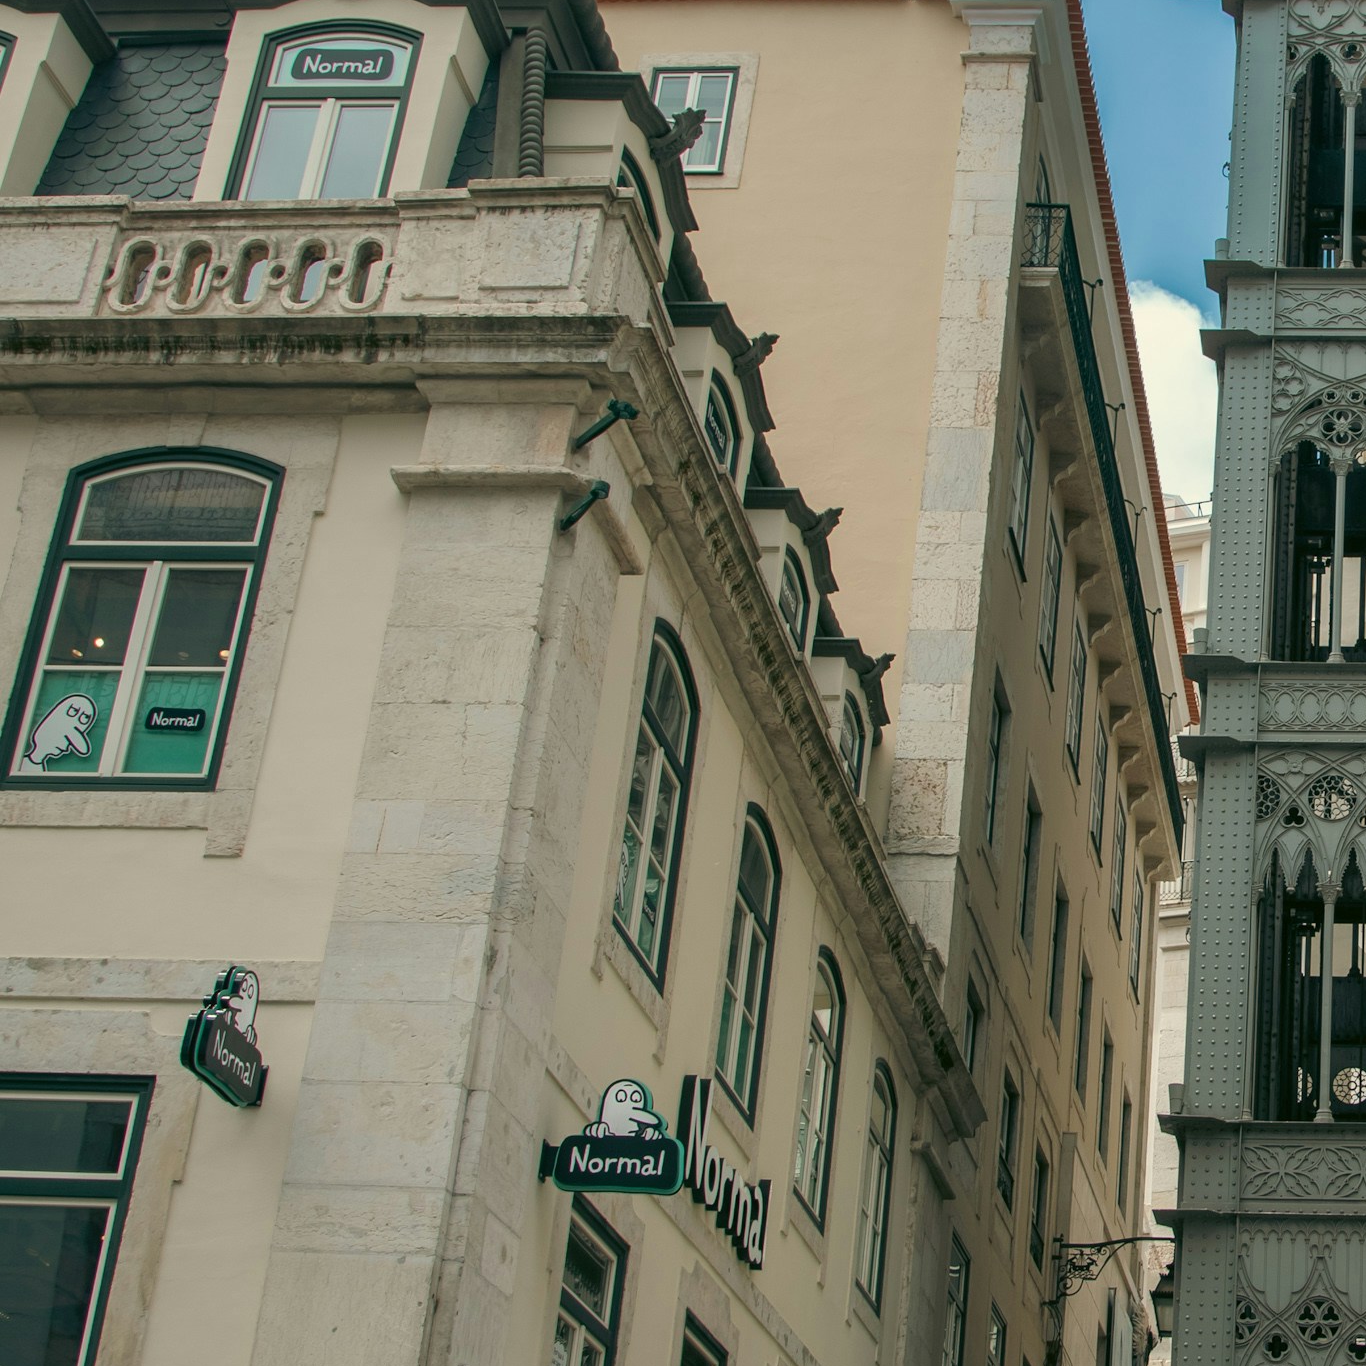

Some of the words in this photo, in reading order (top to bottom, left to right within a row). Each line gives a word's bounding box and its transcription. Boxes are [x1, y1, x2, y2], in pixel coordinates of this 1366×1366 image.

[303, 54, 383, 74] Normal
[151, 711, 200, 727] Normal
[213, 1029, 257, 1087] Normal
[569, 1143, 665, 1176] Normal
[684, 1074, 772, 1265] Normal
